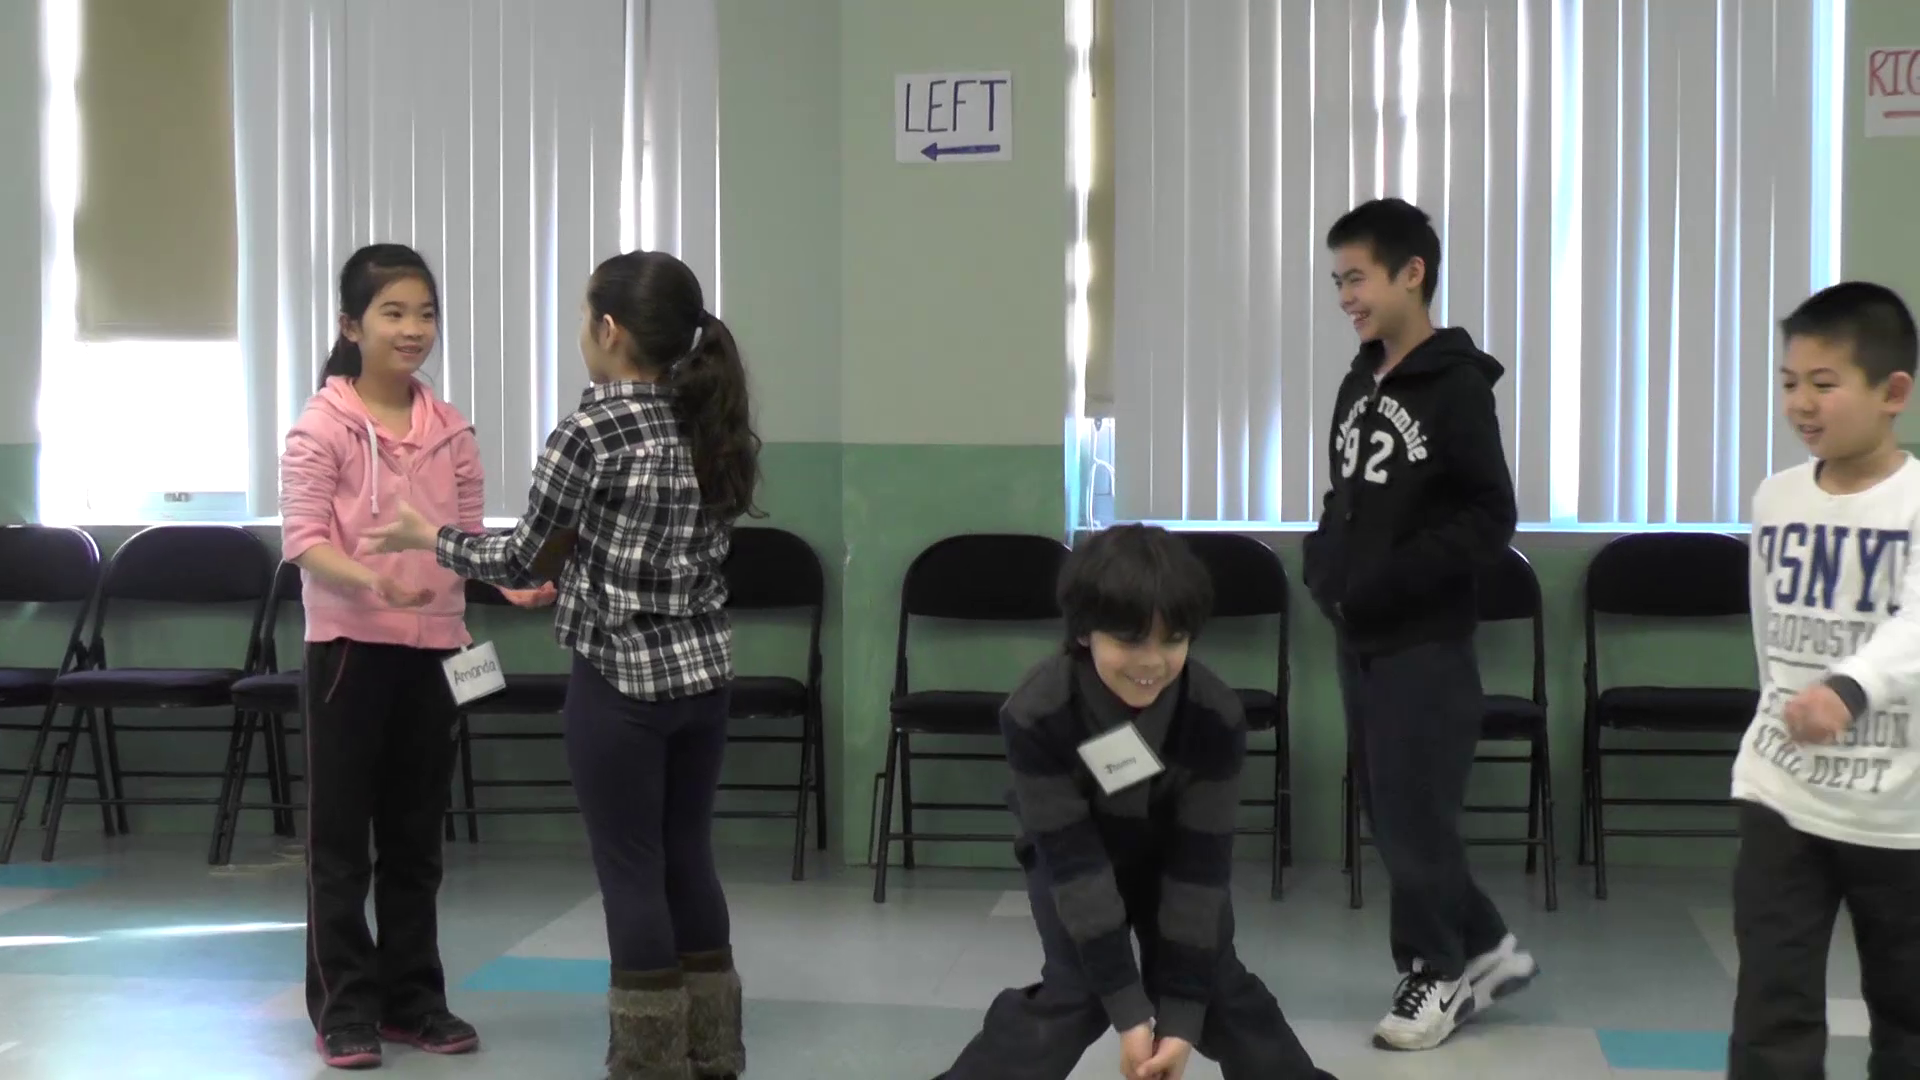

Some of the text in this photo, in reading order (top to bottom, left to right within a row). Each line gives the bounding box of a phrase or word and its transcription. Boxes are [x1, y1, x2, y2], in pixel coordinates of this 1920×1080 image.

[905, 79, 1008, 132] LEFT
[1341, 428, 1395, 484] 92
[453, 659, 497, 687] Amanda
[1807, 755, 1893, 794] DEPT
